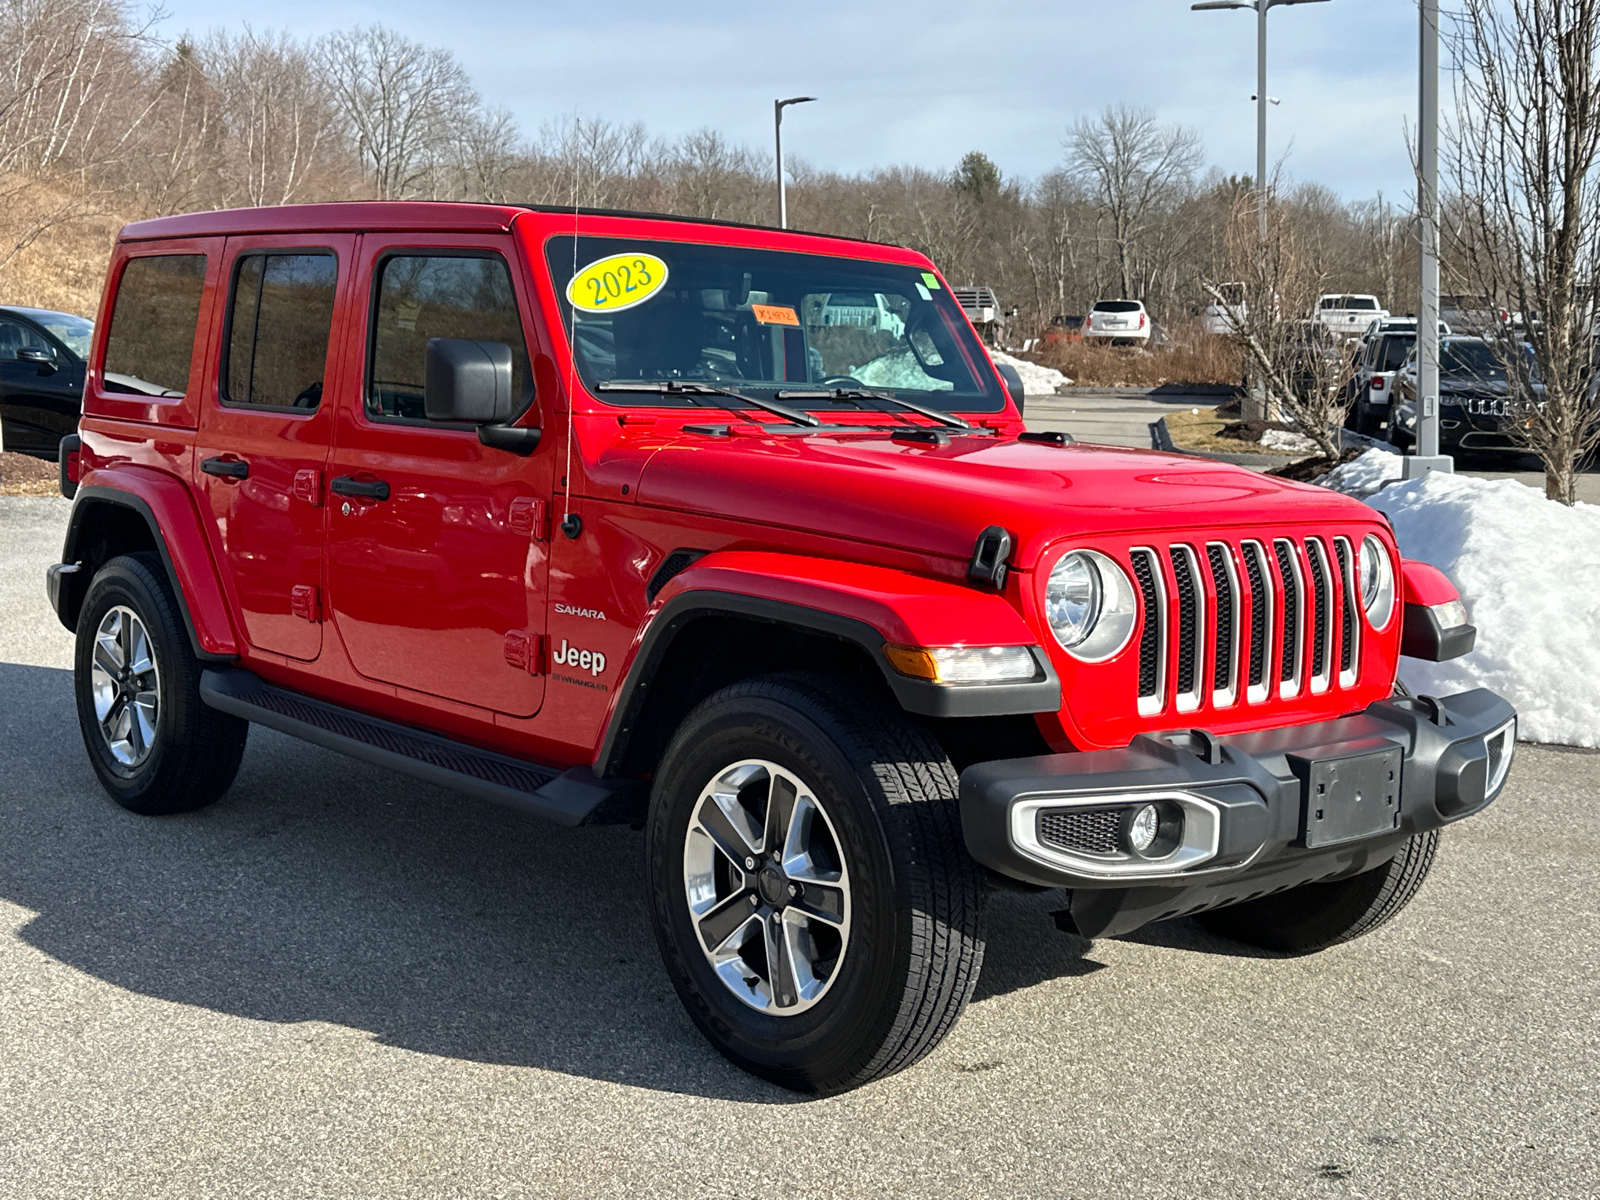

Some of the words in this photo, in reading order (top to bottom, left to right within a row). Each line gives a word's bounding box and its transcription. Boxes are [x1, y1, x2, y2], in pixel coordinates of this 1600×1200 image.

[586, 259, 652, 306] 2023
[554, 603, 606, 620] SAHARA
[553, 639, 606, 677] Jeep
[560, 674, 608, 692] WRANGLER
